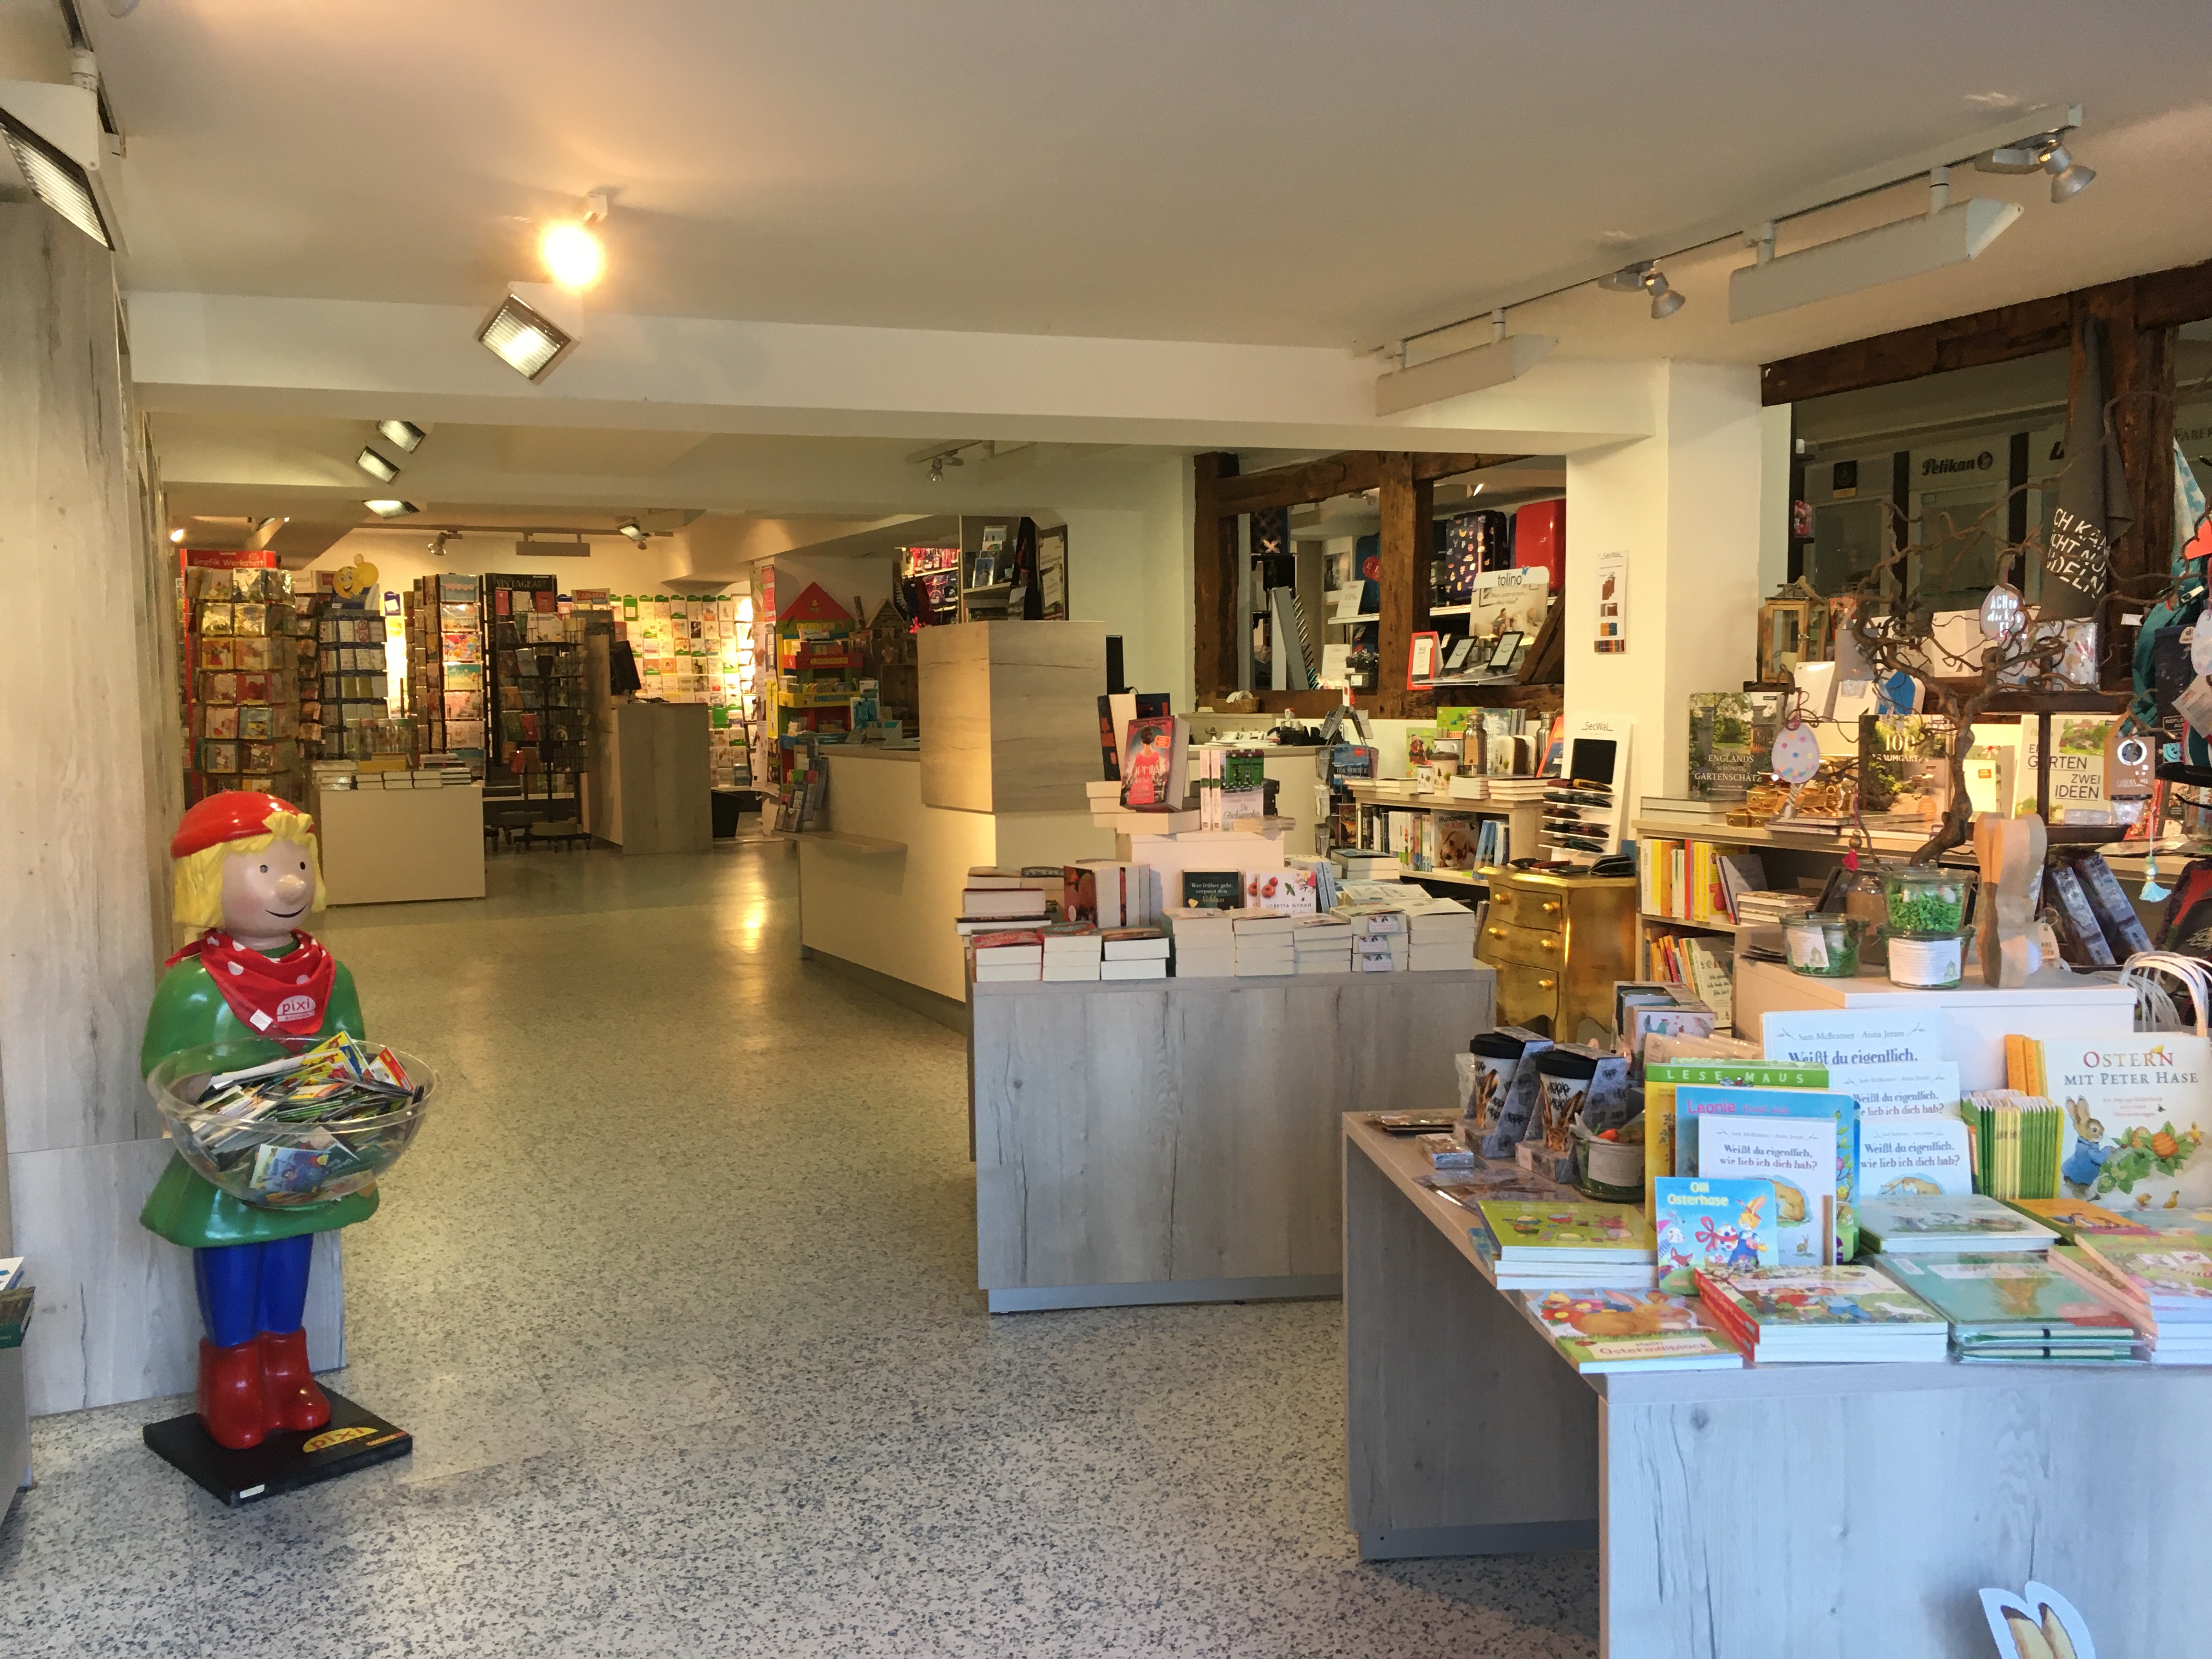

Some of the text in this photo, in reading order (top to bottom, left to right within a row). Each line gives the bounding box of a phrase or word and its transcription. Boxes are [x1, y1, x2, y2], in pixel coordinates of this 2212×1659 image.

[1921, 458, 1975, 476] Pelikan
[2053, 508, 2074, 531] CH
[2050, 533, 2081, 554] ICHT
[193, 557, 264, 567] Grafik Werkstatt
[495, 578, 532, 589] VINTAGE
[1497, 572, 1522, 586] tolino
[1990, 595, 2008, 610] ACH
[1885, 734, 1916, 752] 100
[1708, 754, 1754, 763] ENGLANDS
[2028, 755, 2087, 769] GRTEN
[2070, 774, 2101, 785] ZWEI
[2055, 784, 2100, 799] IDEEN
[282, 998, 310, 1015] pixi
[1816, 1032, 1855, 1040] McBratney
[1883, 1030, 1905, 1039] Jeram
[1788, 1051, 1829, 1065] Weißt
[1832, 1050, 1848, 1065] du
[2083, 1051, 2174, 1068] OSTERN
[1667, 1069, 1805, 1084] LESE MAUS
[2064, 1071, 2199, 1086] MIT PETER HASE
[1853, 1090, 1939, 1104] Weißt du eigentlich,
[1687, 1099, 1736, 1115] Leonie
[1771, 1106, 1790, 1114] sich
[1867, 1104, 1883, 1116] lieb
[1886, 1104, 1899, 1115] ich
[1901, 1104, 1920, 1114] dich
[1922, 1102, 1944, 1114] hab?
[1724, 1144, 1813, 1159] Weißt du eigentlich,
[1865, 1142, 1955, 1154] Weißt du eigentlich,
[1719, 1156, 1818, 1171] wie lieb ich dich hab?
[1860, 1155, 1960, 1169] wie lieb ich dich hab?
[1690, 1181, 1709, 1193] Olli
[1667, 1194, 1729, 1207] Osterhase
[311, 1427, 364, 1449] pixi
